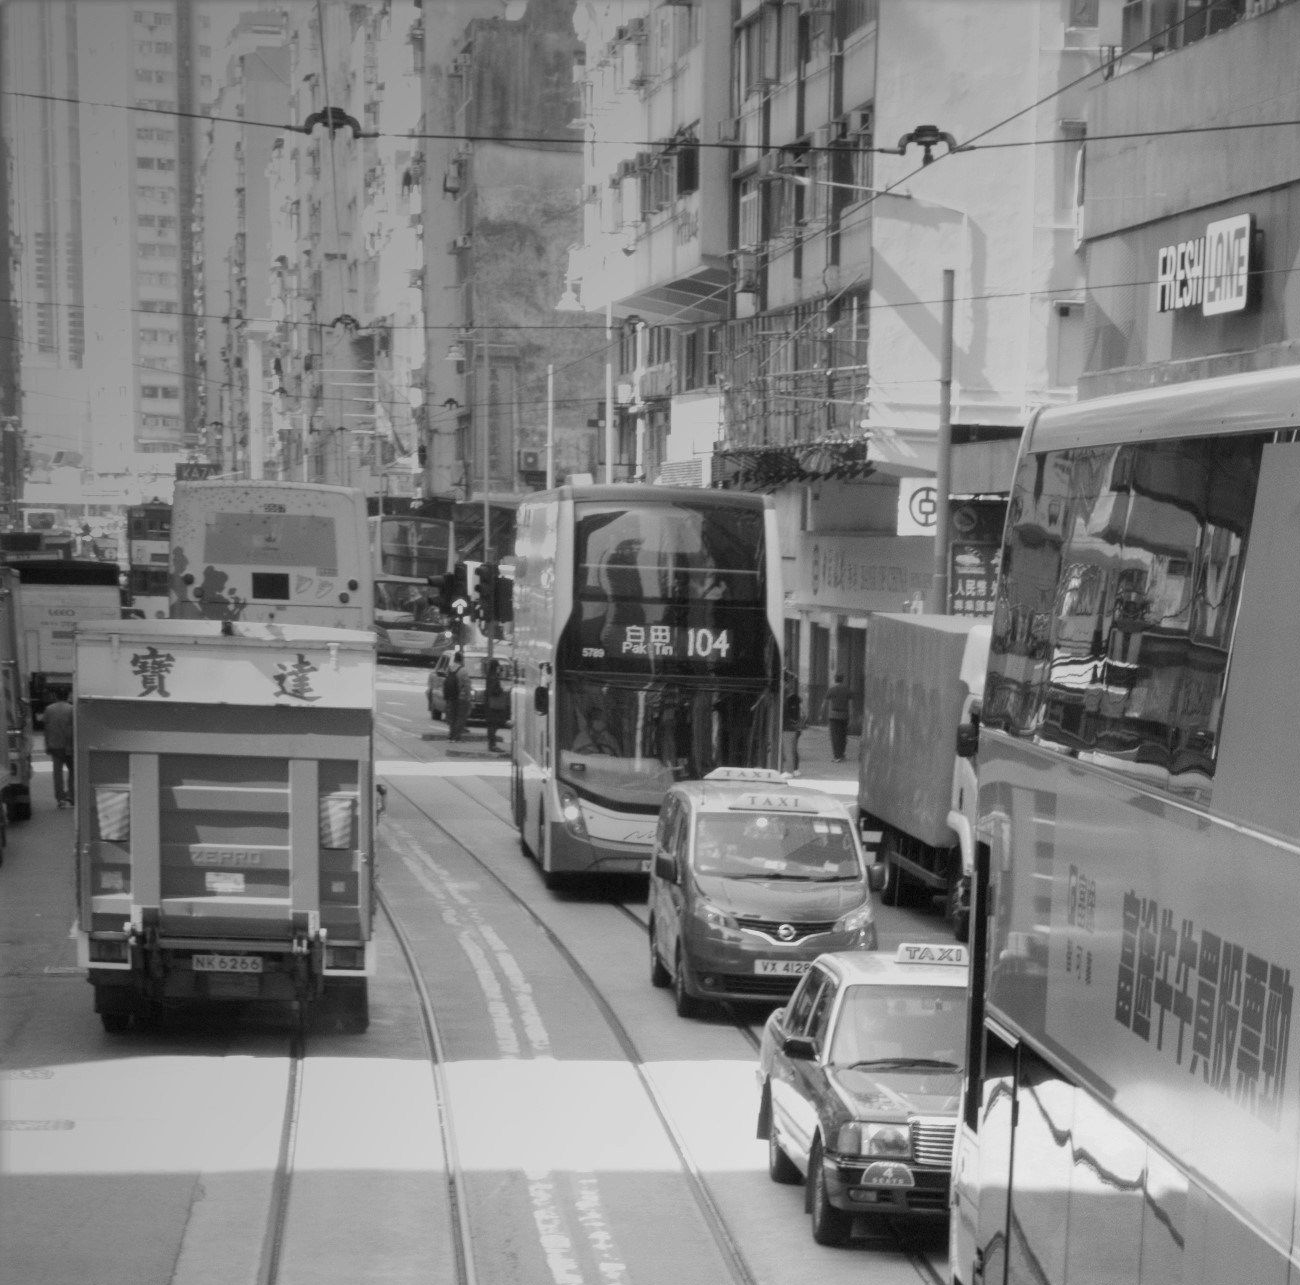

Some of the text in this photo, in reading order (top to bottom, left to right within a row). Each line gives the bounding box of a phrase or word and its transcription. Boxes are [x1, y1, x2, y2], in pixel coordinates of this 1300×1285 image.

[1156, 226, 1247, 313] FRESH LANE
[625, 625, 671, 643] 白田
[621, 641, 674, 656] Pak Tin
[686, 627, 731, 658] 104
[724, 768, 775, 780] TAXI
[748, 795, 801, 809] TAXI
[191, 850, 262, 865] ZEPRO
[905, 945, 964, 962] TAXI
[195, 956, 260, 970] NK 6266
[762, 961, 780, 973] VX
[882, 1167, 894, 1178] 4
